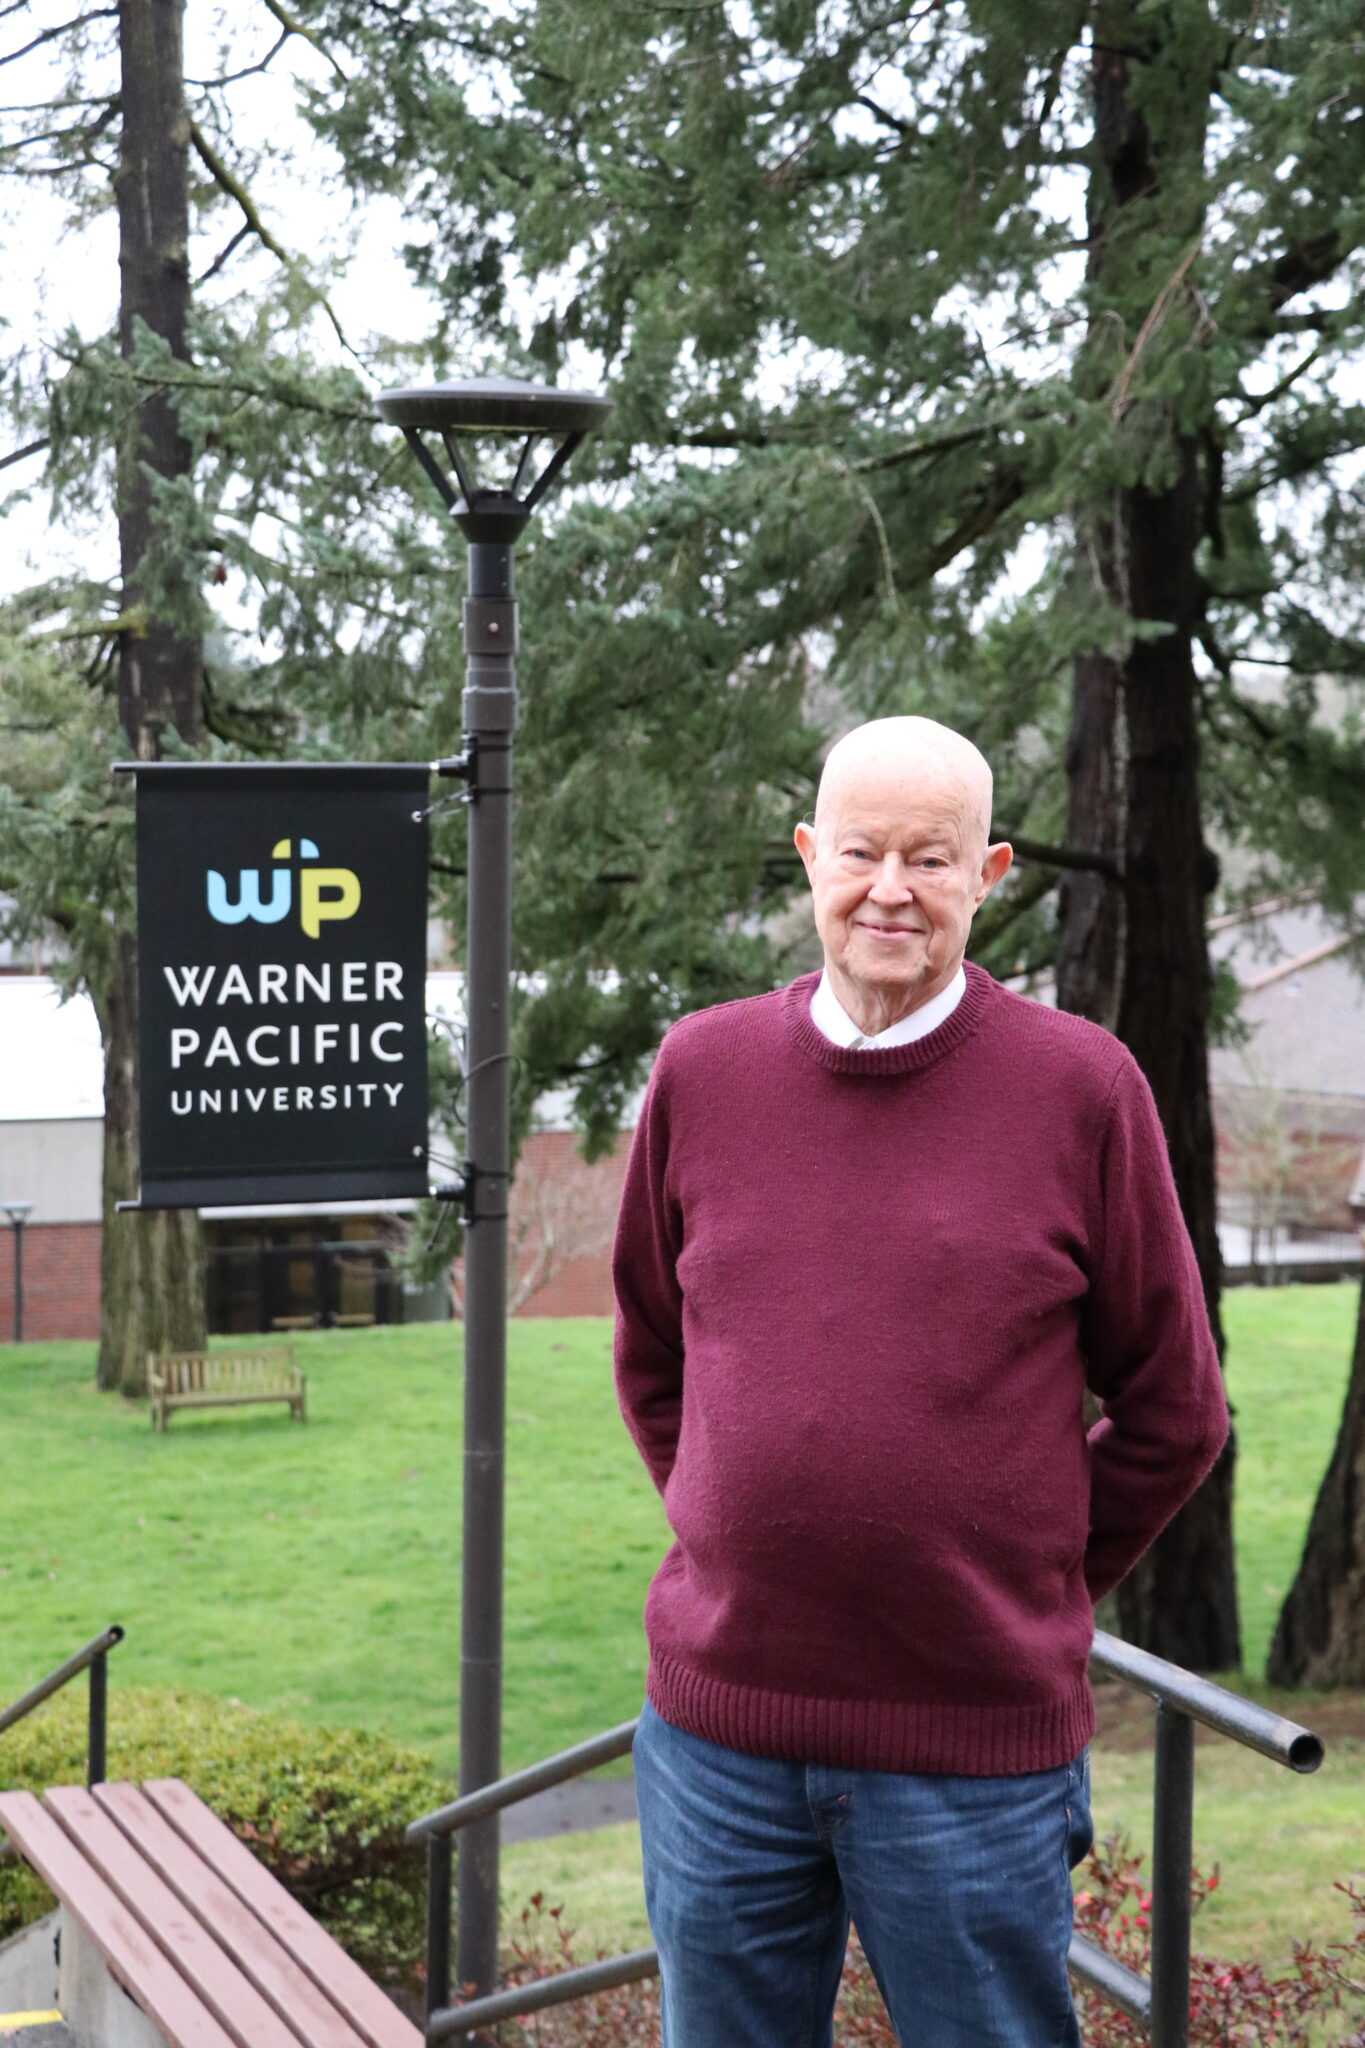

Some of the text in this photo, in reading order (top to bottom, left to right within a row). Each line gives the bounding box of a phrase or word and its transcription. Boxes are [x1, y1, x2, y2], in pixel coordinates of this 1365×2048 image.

[163, 961, 405, 1007] WARNER
[170, 1021, 405, 1069] PACIFIC
[170, 1082, 404, 1116] UNIVERSITY
